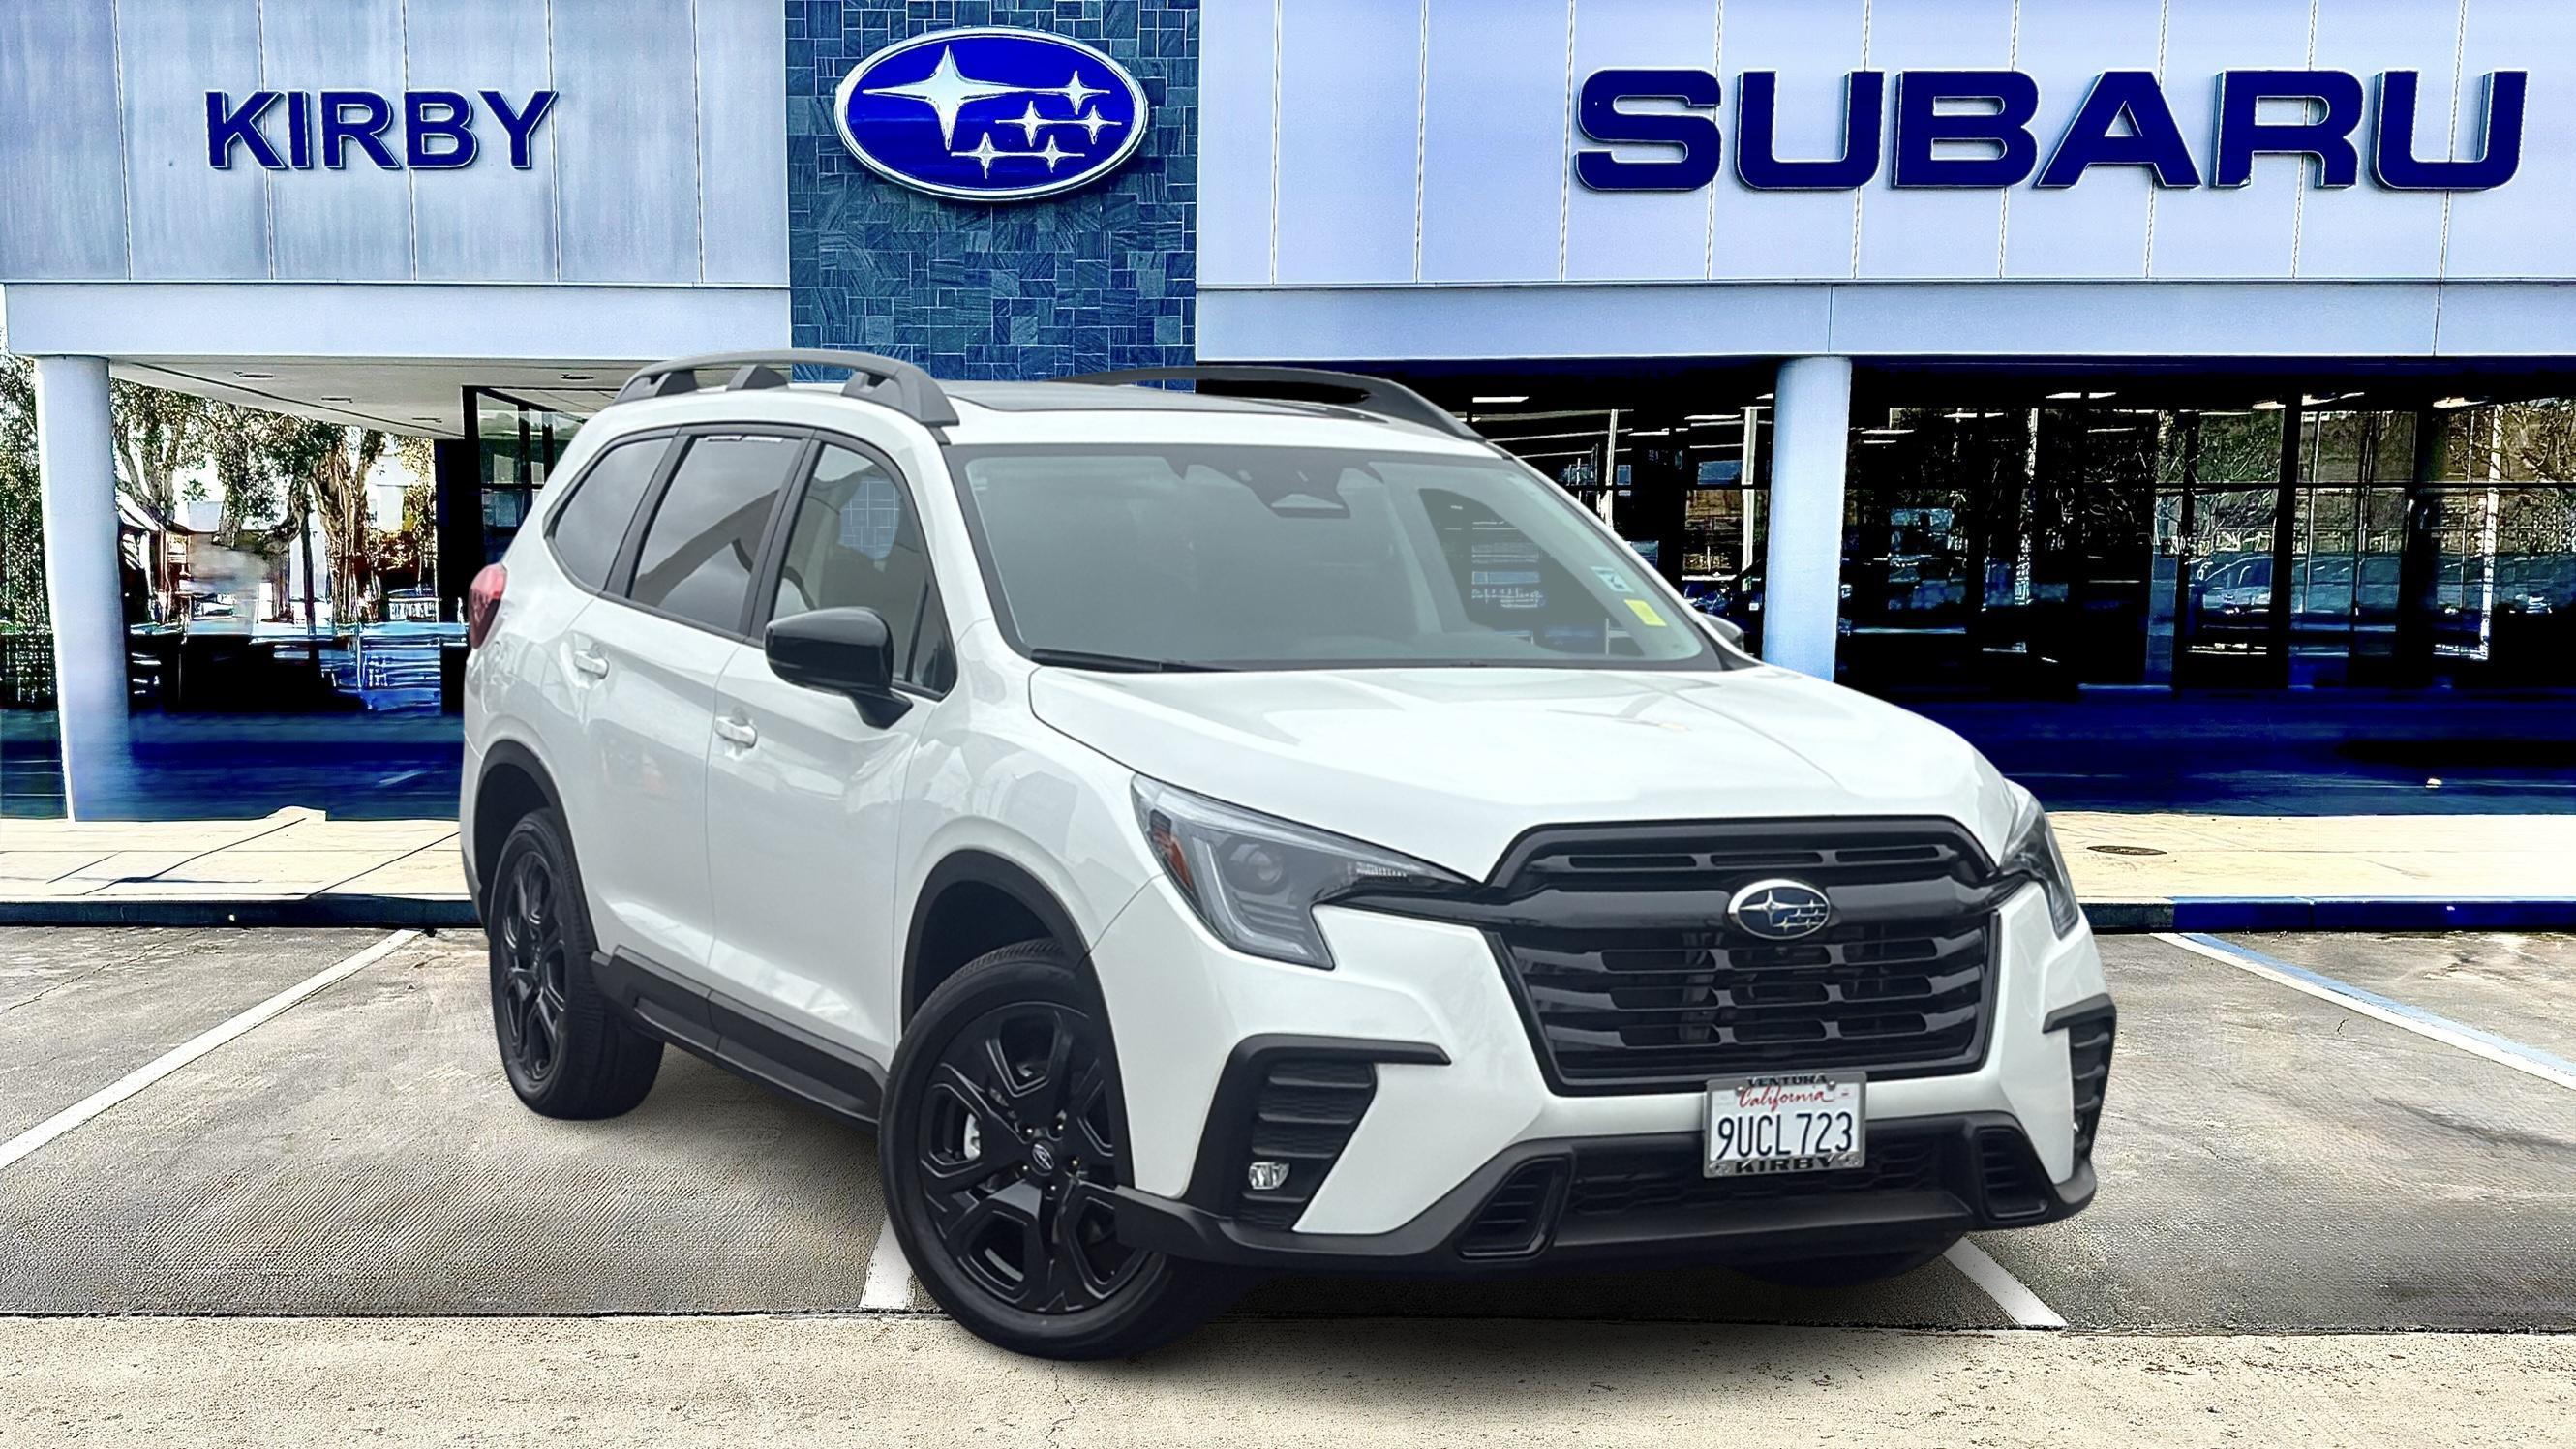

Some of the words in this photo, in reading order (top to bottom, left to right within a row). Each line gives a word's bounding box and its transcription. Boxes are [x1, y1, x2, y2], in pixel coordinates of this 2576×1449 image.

[205, 90, 559, 169] KIRBY
[1575, 68, 2529, 191] SUBARU
[1739, 1085, 1835, 1112] California
[1746, 1074, 1829, 1087] VENTURA
[1716, 1111, 1853, 1160] 9UCL723
[1734, 1154, 1835, 1174] KIRBY
